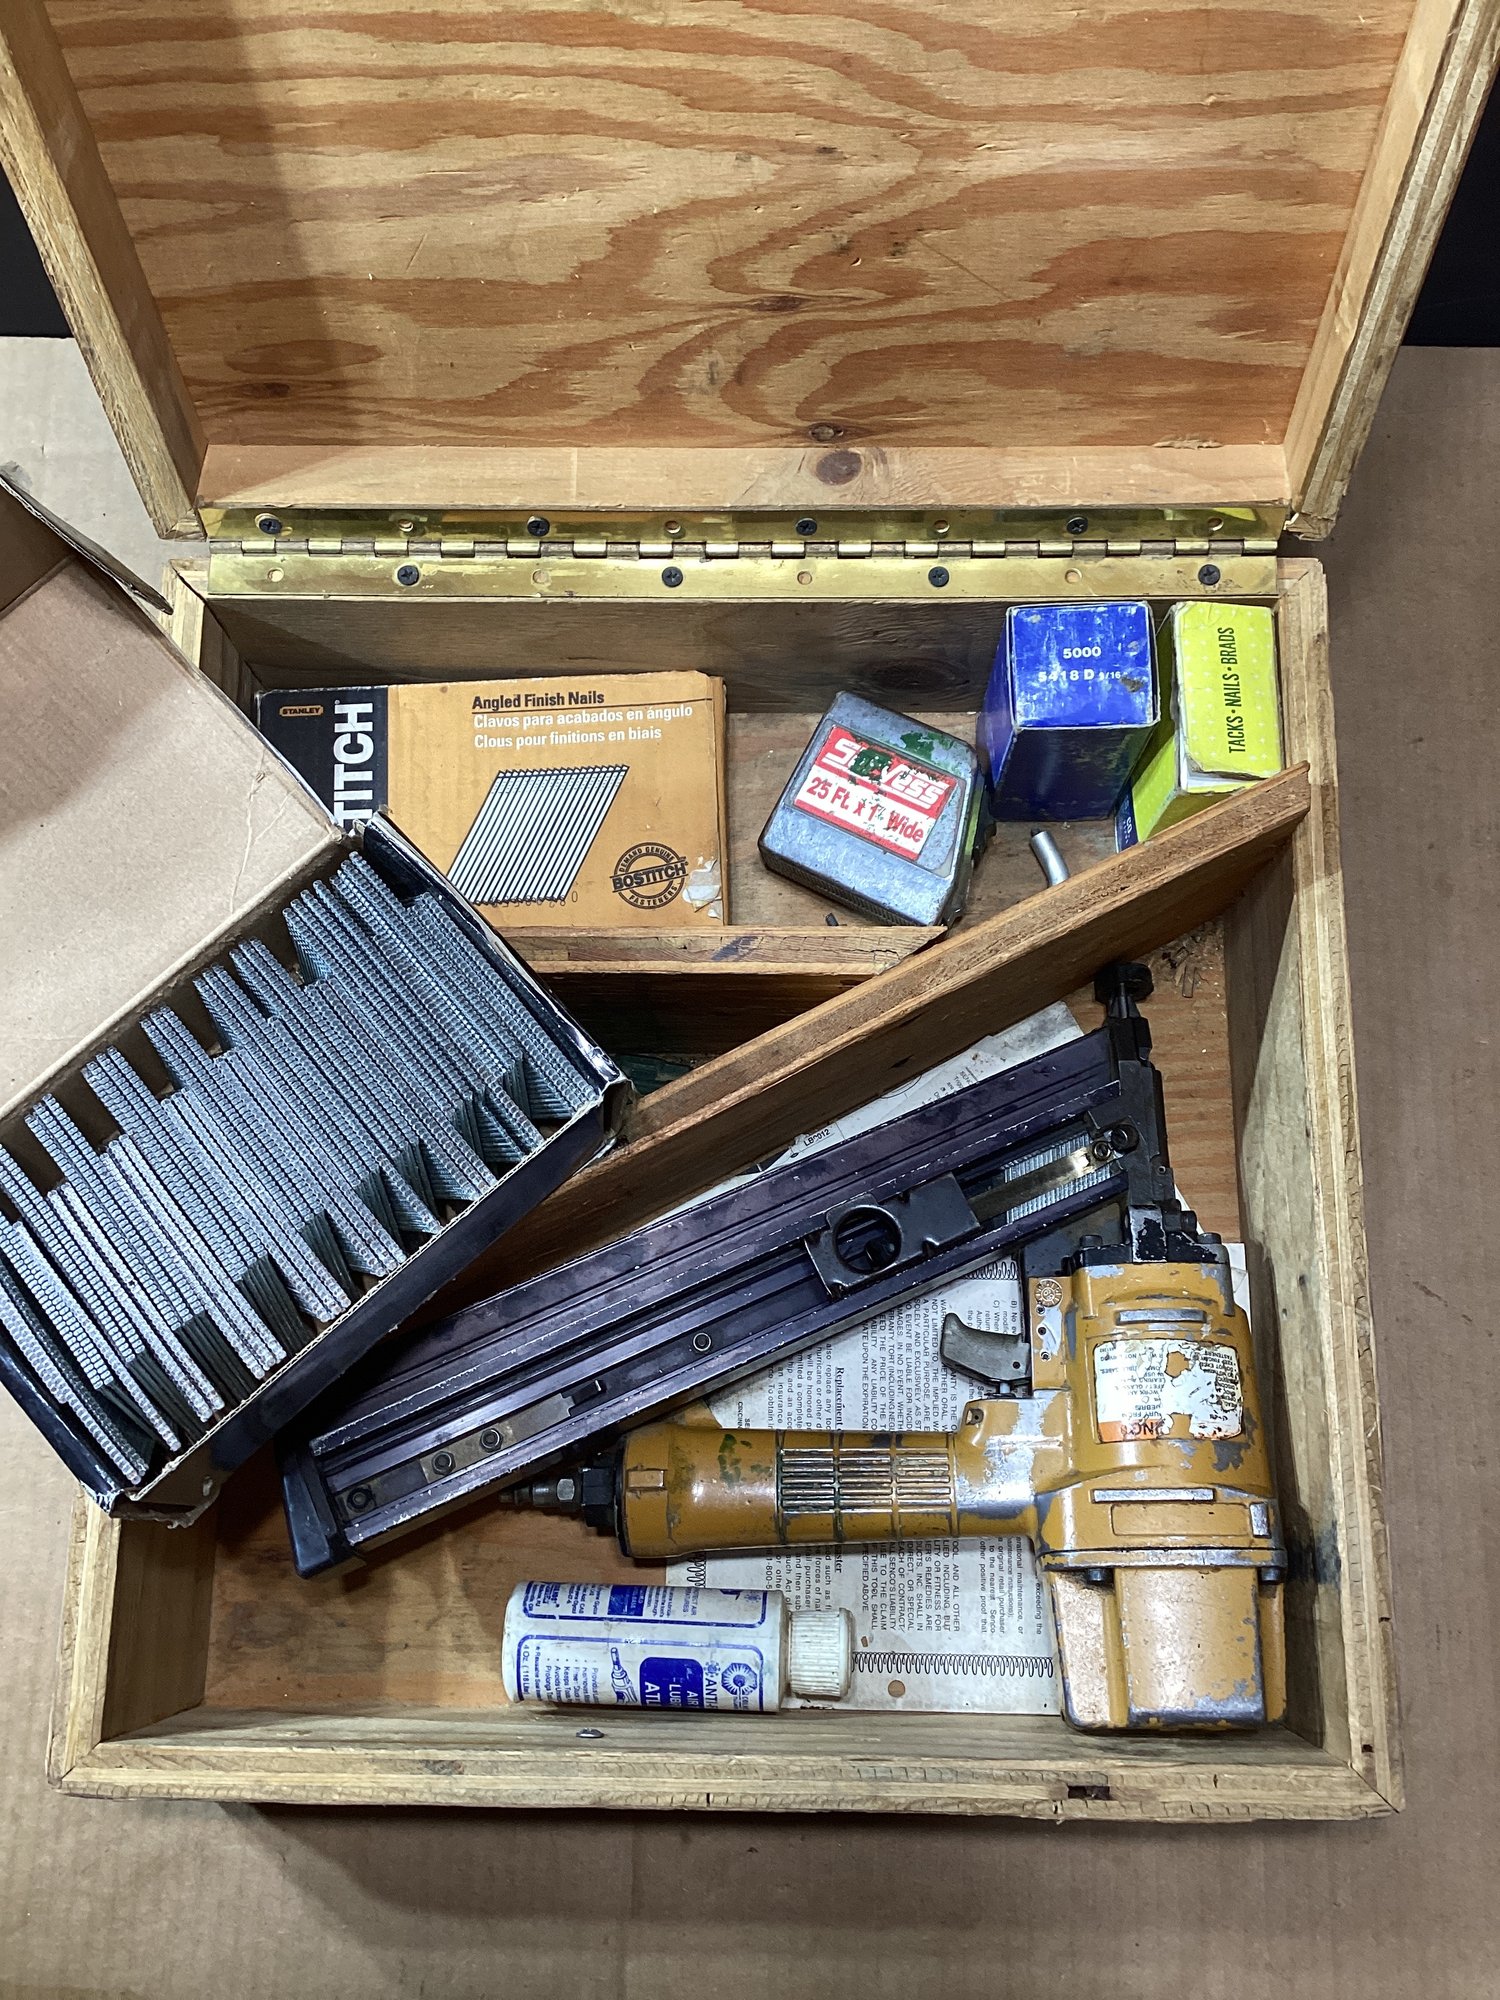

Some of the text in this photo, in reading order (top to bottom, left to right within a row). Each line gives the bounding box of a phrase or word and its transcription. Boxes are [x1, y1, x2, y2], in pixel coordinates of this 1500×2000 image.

[1063, 646, 1102, 659] 5000
[1084, 668, 1095, 681] D
[1217, 627, 1246, 754] TACKS NAILS BRADS
[472, 690, 605, 711] Angled Finish Nails
[282, 706, 322, 715] STANLEY
[473, 703, 693, 730] Clavos para acabados en ángulo
[473, 726, 662, 751] Clous pour finitions en biais
[333, 702, 374, 828] TITCH
[806, 776, 832, 800] 25
[830, 786, 850, 811] Ft.
[853, 799, 866, 817] x
[886, 811, 924, 843] Wide
[619, 846, 676, 873] DEMAND GENUINE
[612, 862, 686, 890] BOSTITCH
[628, 885, 678, 906] FASTENERS
[913, 1298, 921, 1327] SOLELY
[931, 1298, 939, 1315] NOT
[905, 1313, 913, 1339] EVENT
[922, 1307, 930, 1357] PARTICULAR
[931, 1318, 939, 1348] LIMITED
[897, 1341, 904, 1350] IN
[905, 1342, 913, 1353] BE
[914, 1330, 922, 1347] AND
[806, 1353, 814, 1367] will
[861, 1341, 869, 1364] UPON
[897, 1353, 904, 1365] NO
[806, 1371, 813, 1381] be
[824, 1364, 833, 1394] replace
[905, 1357, 913, 1383] LIABLE
[914, 1350, 922, 1402] EXCLUSIVELY
[768, 1384, 774, 1394] To
[816, 1387, 823, 1396] or
[835, 1367, 845, 1425] Replacement
[879, 1386, 886, 1397] OF
[887, 1365, 895, 1410] (INCLUDING
[905, 1387, 913, 1404] FOR
[787, 1397, 794, 1408] an
[824, 1398, 833, 1414] any
[950, 1393, 958, 1402] IS
[914, 1405, 922, 1417] AS
[923, 1405, 931, 1422] ARE
[950, 1405, 958, 1421] THE
[1011, 1312, 1018, 1323] No
[1017, 1626, 1023, 1635] or
[979, 1540, 987, 1560] other
[996, 1545, 1005, 1572] original
[880, 1564, 887, 1576] TO
[898, 1567, 905, 1579] OF
[934, 1560, 941, 1573] OR
[952, 1563, 960, 1581] AND
[785, 1578, 793, 1593] Act
[803, 1565, 811, 1608] purchaser
[907, 1579, 914, 1592] OR
[978, 1563, 987, 1592] positive
[815, 1586, 822, 1595] of
[825, 1589, 830, 1600] as
[952, 1584, 960, 1599] ALL
[979, 1595, 987, 1615] proof
[871, 1603, 879, 1630] SHALL
[880, 1603, 888, 1631] CLAIM
[934, 1614, 942, 1632] FOR
[943, 1615, 951, 1632] BUT
[952, 1603, 960, 1632] OTHER
[996, 1597, 1005, 1633] purchaser
[916, 1622, 923, 1631] IN
